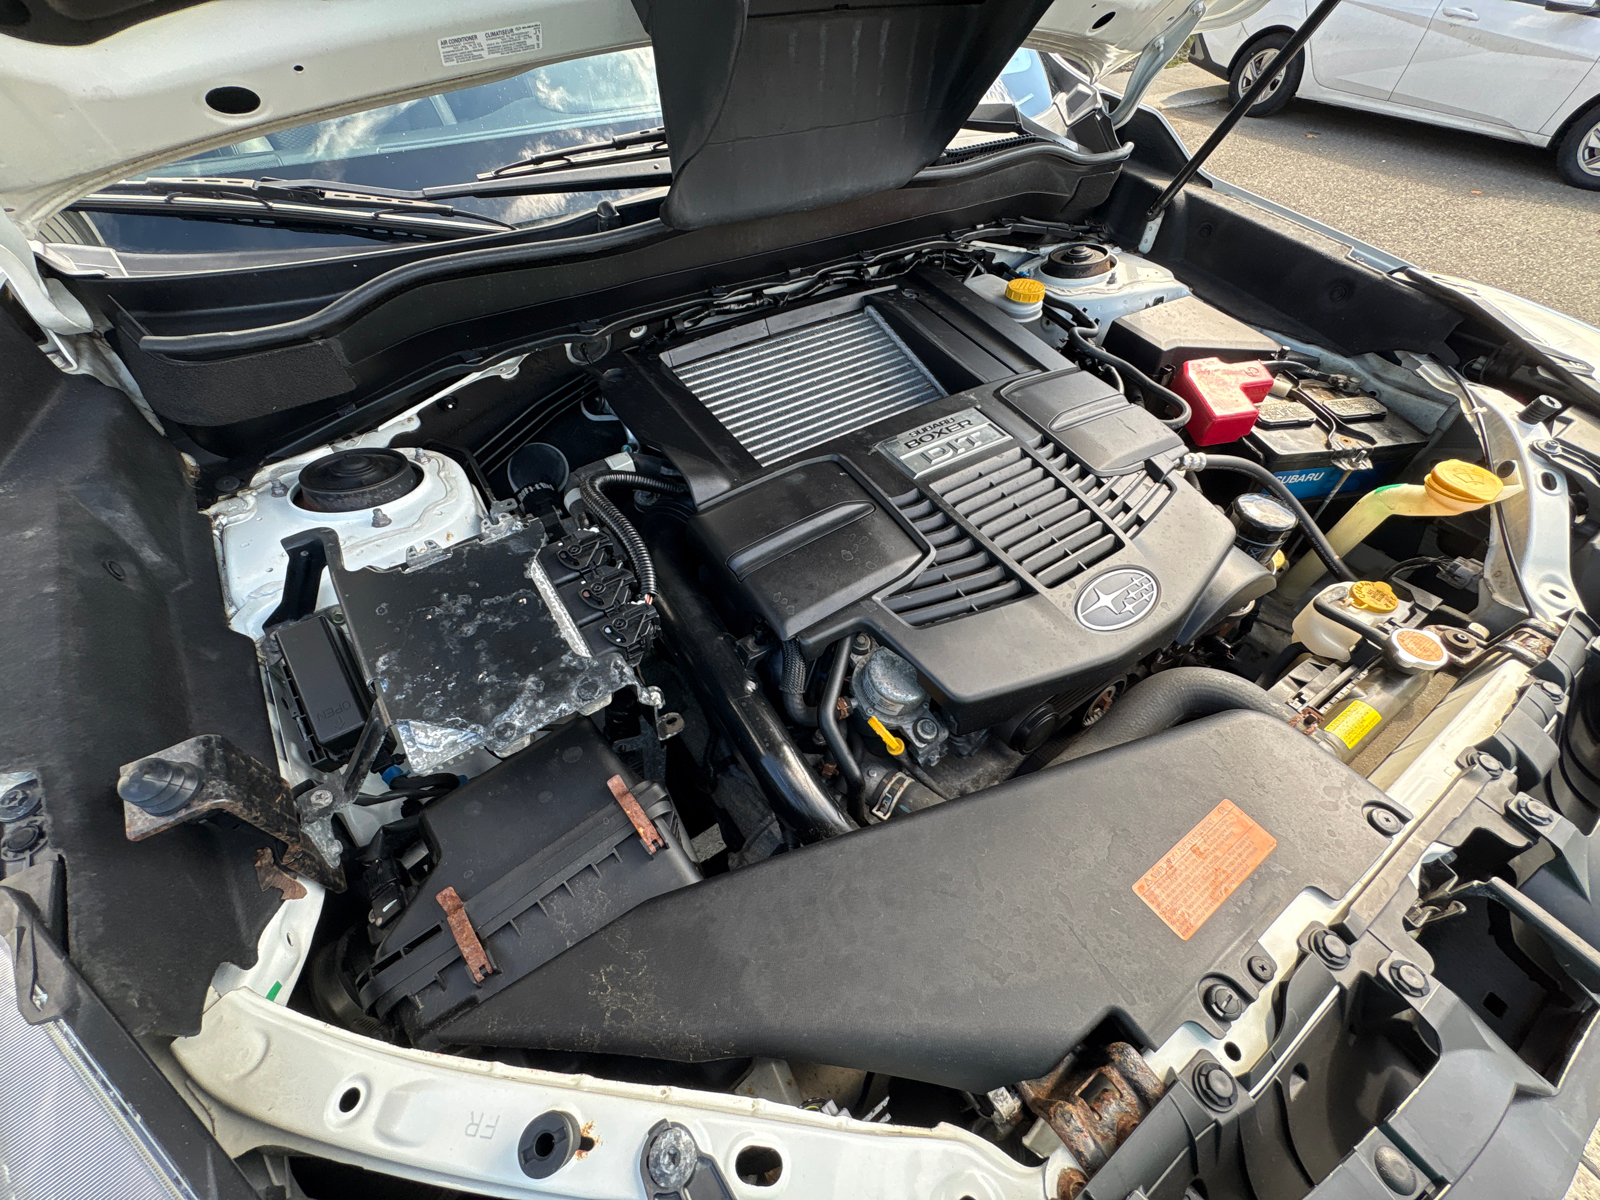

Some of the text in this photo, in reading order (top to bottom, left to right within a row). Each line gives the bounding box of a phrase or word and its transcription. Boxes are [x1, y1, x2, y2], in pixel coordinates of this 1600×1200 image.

[448, 34, 478, 45] CONDITIONER
[484, 28, 514, 39] CLIMATISEUR
[904, 418, 974, 449] BOXER
[908, 417, 956, 438] SUBARU
[919, 431, 982, 465] DIT
[1276, 471, 1325, 484] SUBARU
[316, 700, 351, 720] OPEN
[1177, 818, 1215, 854] AVERTISSEMENT
[465, 1110, 501, 1140] FR
